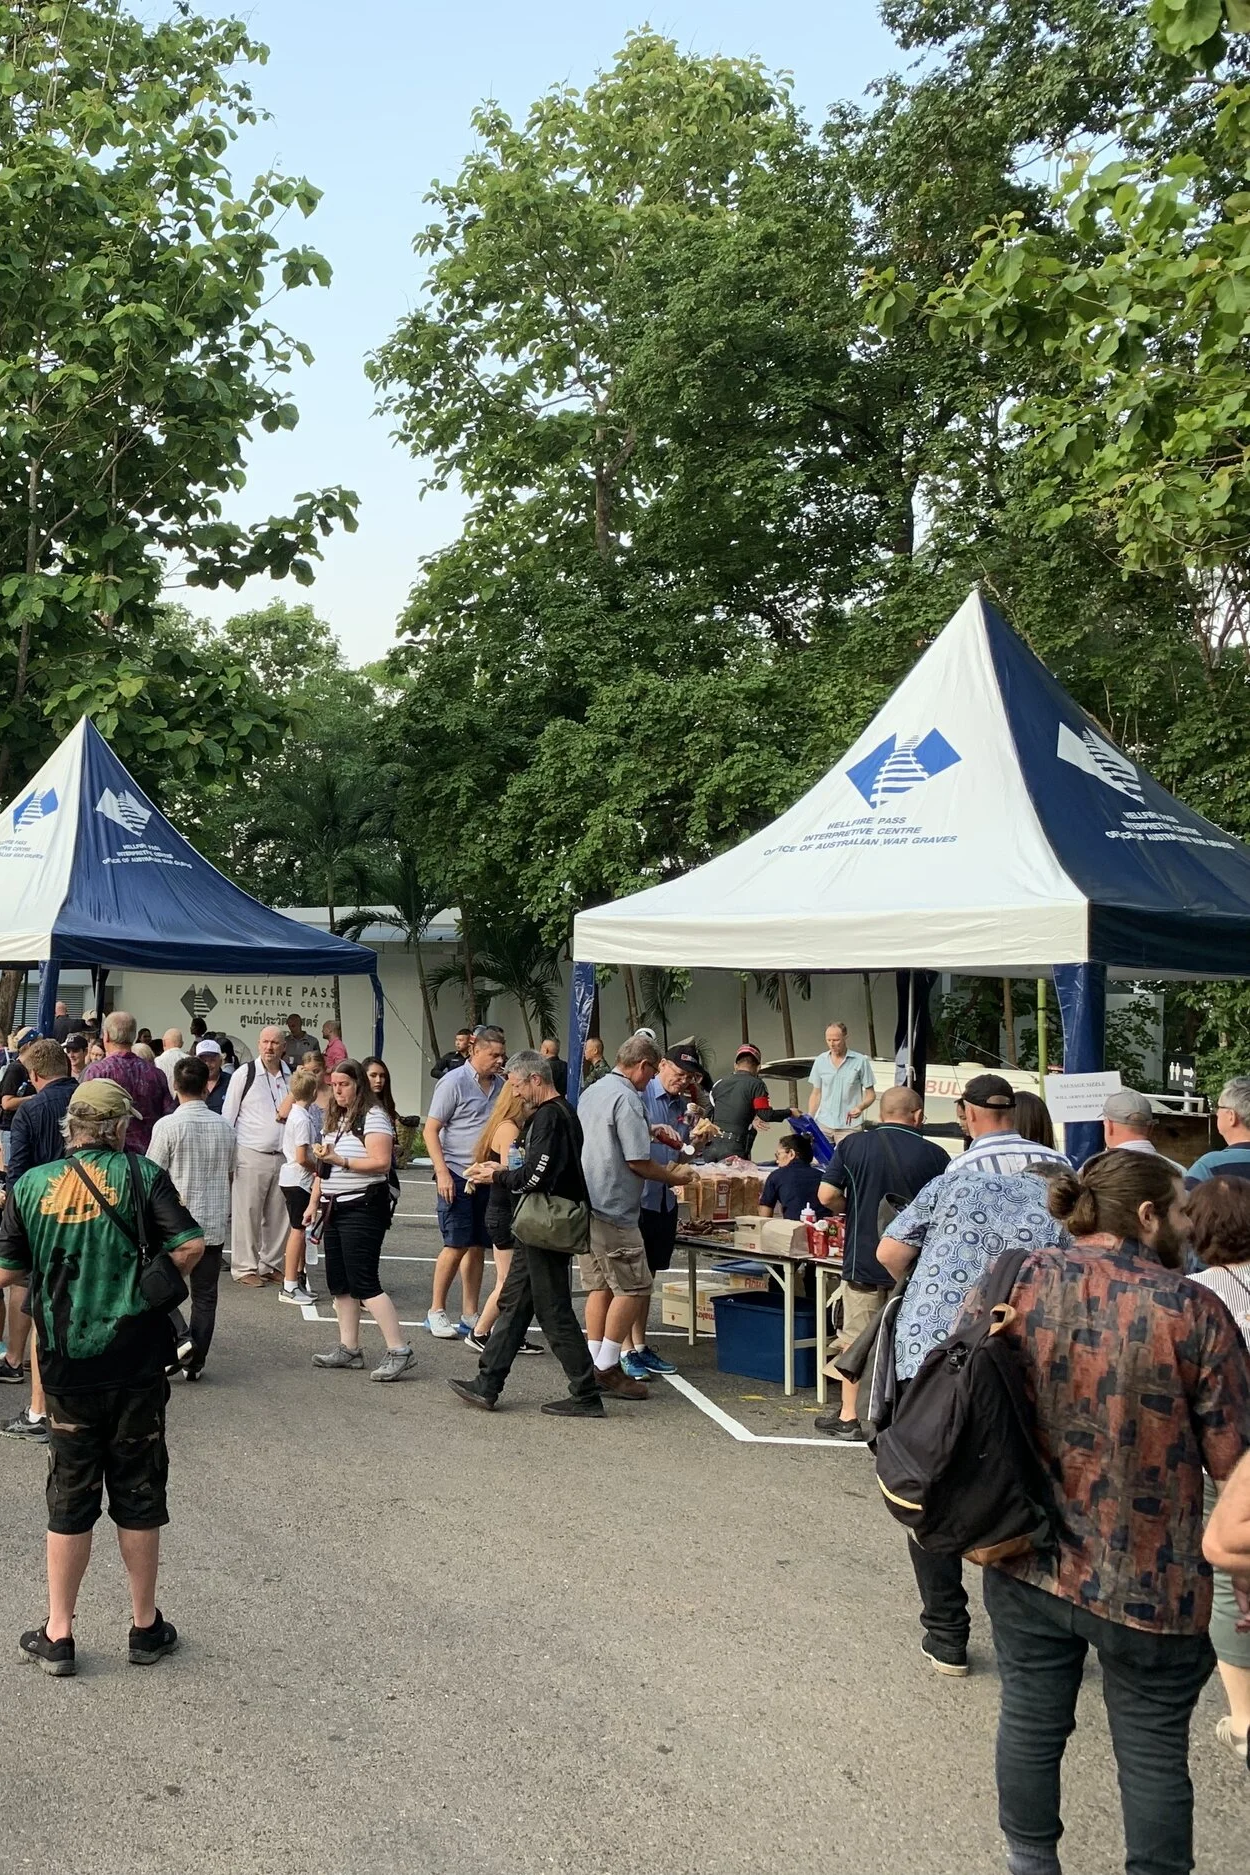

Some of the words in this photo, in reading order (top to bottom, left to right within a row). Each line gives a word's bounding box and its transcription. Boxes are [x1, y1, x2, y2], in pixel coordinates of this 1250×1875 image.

[827, 817, 874, 829] HELLFIRE
[878, 816, 907, 825] PASS
[803, 828, 874, 842] INTERPRETIVE
[877, 826, 922, 835] CENTRE
[799, 844, 813, 852] OF
[815, 838, 880, 850] AUSTRALIAN
[883, 837, 908, 845] WAR
[911, 835, 958, 844] GRAVES
[225, 984, 292, 997] HELLFIRE
[301, 986, 337, 999] PASS
[224, 998, 292, 1007] INTERPRETIVE
[535, 1154, 550, 1172] BIR
